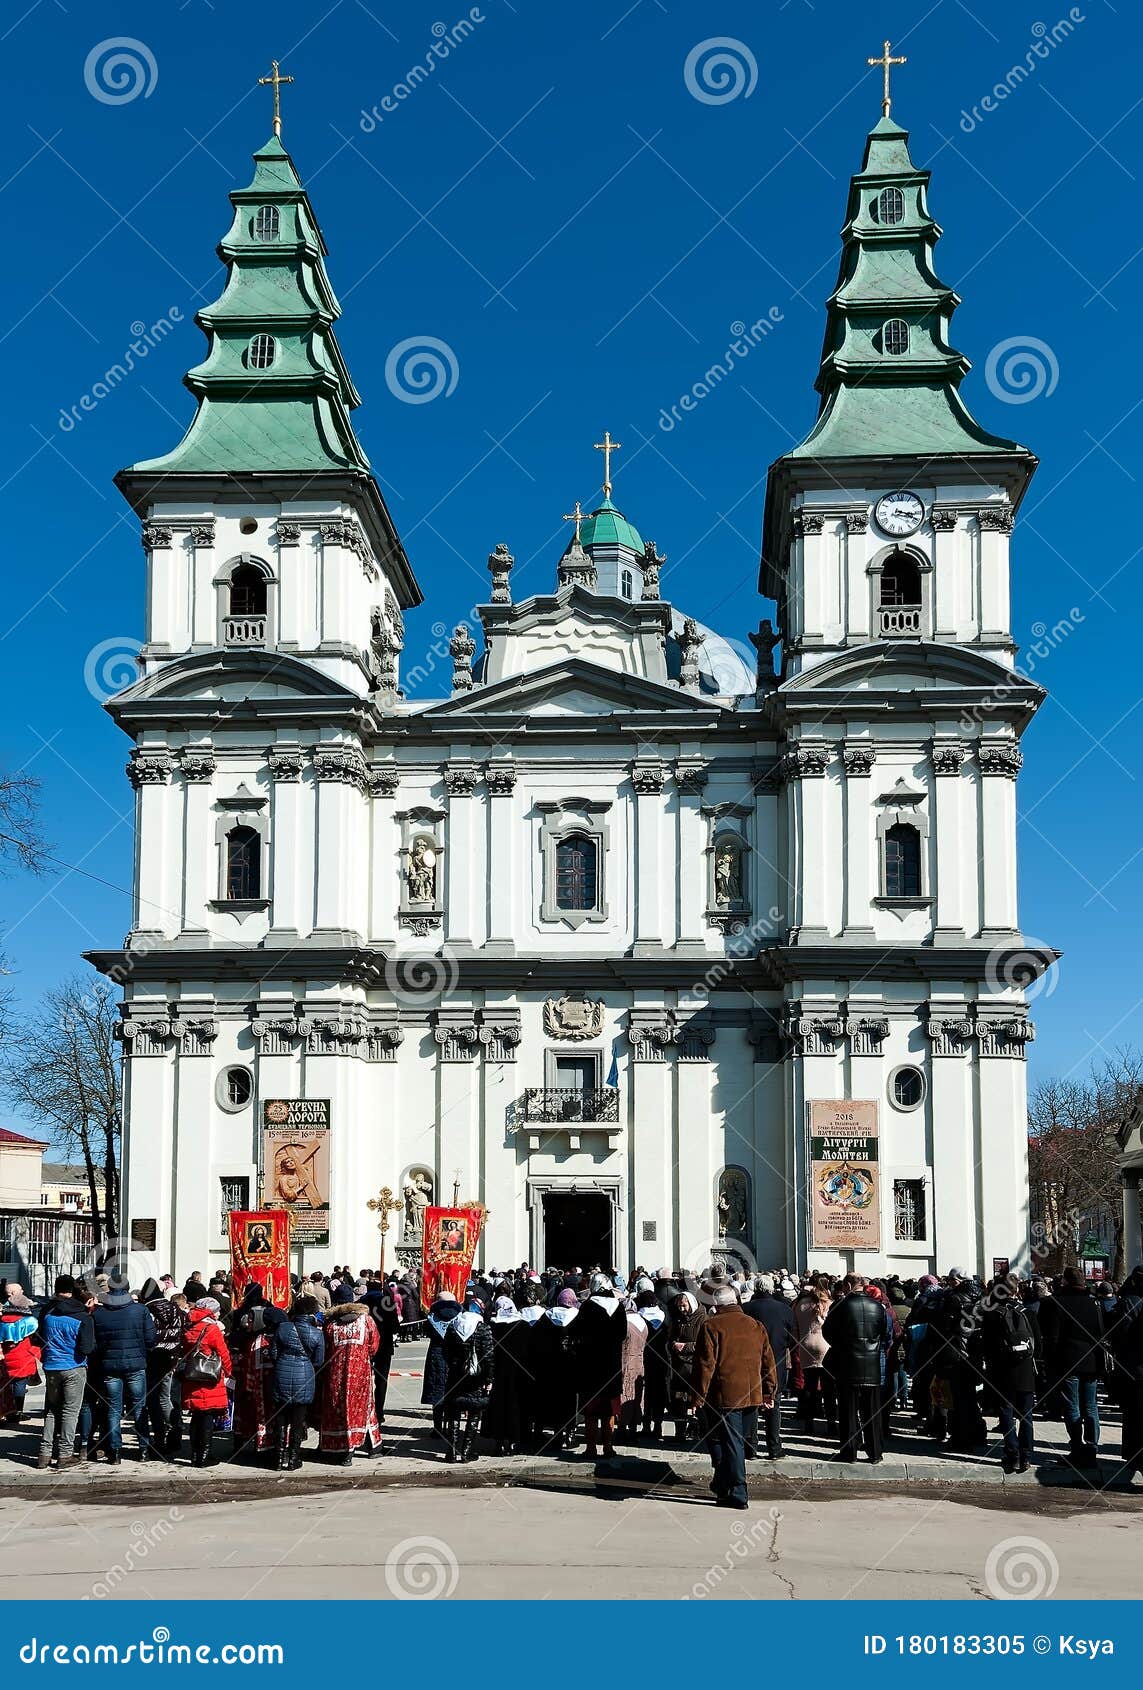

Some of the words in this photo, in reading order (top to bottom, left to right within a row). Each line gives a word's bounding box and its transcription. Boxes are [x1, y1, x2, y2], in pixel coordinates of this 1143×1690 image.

[288, 1101, 327, 1112] ХРЕСНА
[288, 1112, 327, 1124] ДОРОГА
[835, 1113, 854, 1121] 2018
